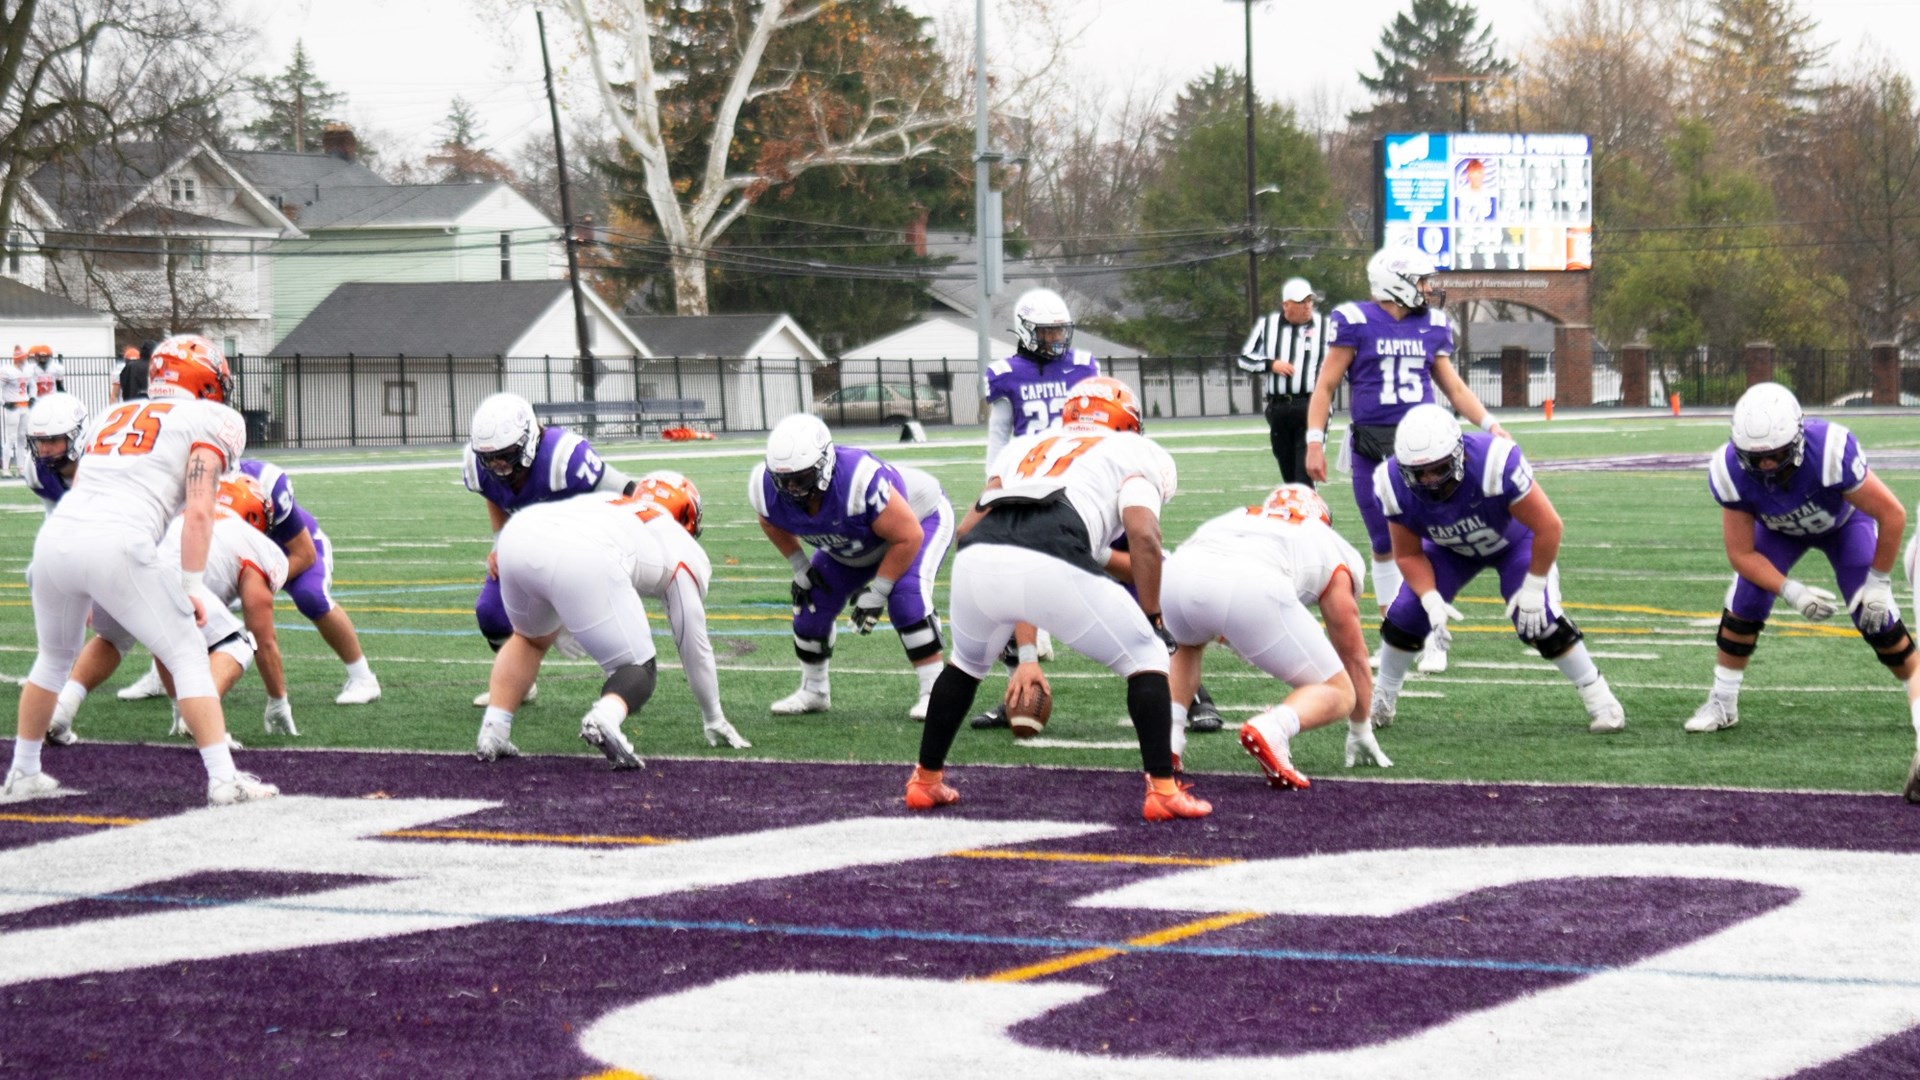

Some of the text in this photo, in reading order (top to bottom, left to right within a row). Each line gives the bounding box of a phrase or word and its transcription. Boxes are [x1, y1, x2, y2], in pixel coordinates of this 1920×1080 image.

[1423, 227, 1443, 255] 0
[1443, 279, 1473, 288] Richard
[1524, 279, 1549, 290] Family
[1376, 339, 1426, 356] CAPITAL
[1021, 382, 1068, 401] CAPITAL
[1380, 357, 1425, 405] 15
[86, 403, 175, 455] 25
[576, 448, 603, 487] 73
[1015, 436, 1106, 480] 47
[1761, 501, 1821, 523] CAPITAL
[1427, 515, 1487, 538] CAPITAL
[1432, 527, 1509, 557] 52
